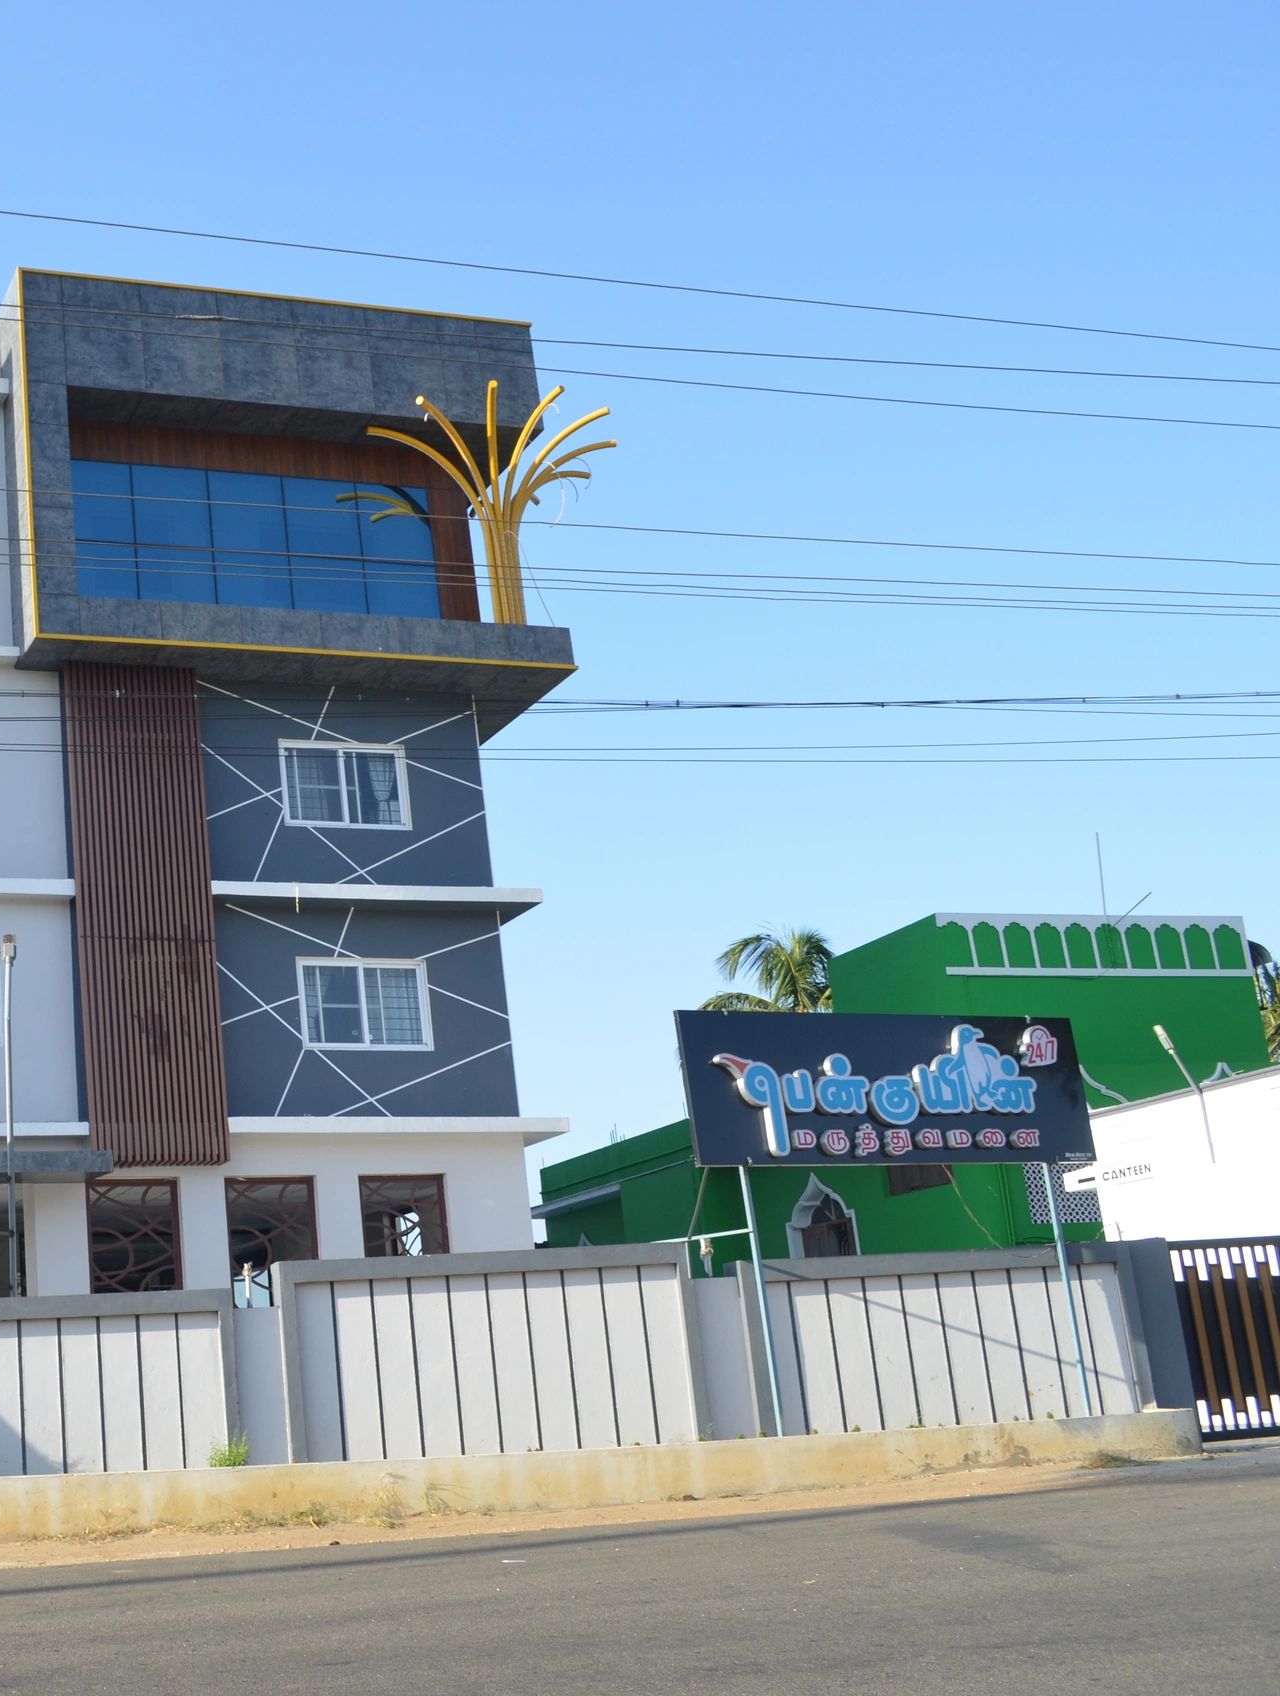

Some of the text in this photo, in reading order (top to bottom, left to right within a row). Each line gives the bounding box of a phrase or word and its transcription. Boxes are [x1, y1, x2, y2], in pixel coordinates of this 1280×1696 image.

[1026, 1040, 1055, 1064] 24/7
[793, 1124, 1040, 1156] மருத்துவமனை
[1102, 1163, 1151, 1181] CANTEEN
